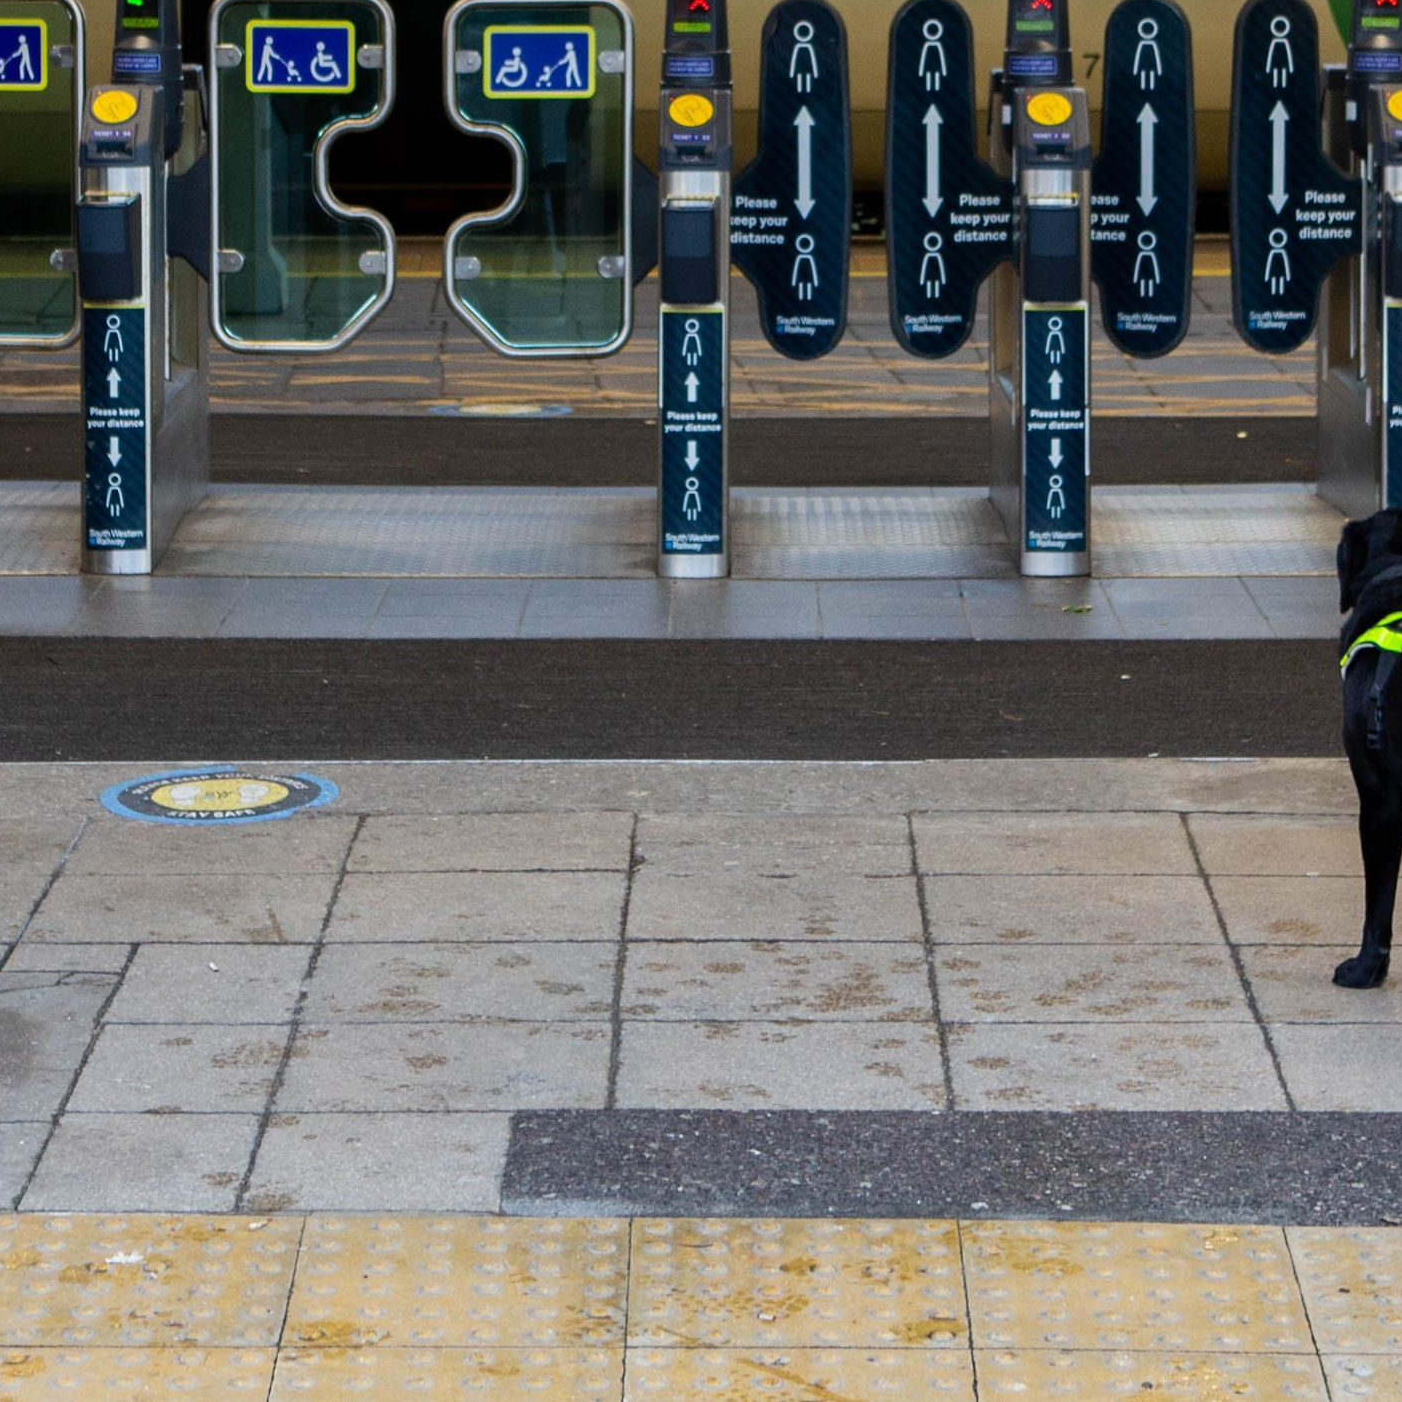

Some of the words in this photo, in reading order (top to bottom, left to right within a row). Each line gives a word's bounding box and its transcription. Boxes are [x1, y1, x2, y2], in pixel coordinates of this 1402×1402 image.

[735, 196, 778, 210] Please
[959, 194, 1001, 207] Please
[1304, 190, 1346, 204] Please
[950, 212, 980, 227] keep
[982, 213, 1011, 227] your
[1100, 213, 1130, 226] your
[1295, 208, 1326, 223] keep
[1327, 210, 1356, 224] your
[759, 216, 788, 230] your
[730, 232, 785, 245] distance
[953, 230, 1008, 243] distance
[1299, 226, 1352, 240] distance
[89, 406, 118, 417] Please
[118, 407, 141, 418] keep
[667, 410, 695, 421] Please
[696, 411, 718, 422] keep
[1030, 408, 1059, 418] Please
[1060, 409, 1081, 419] keep
[87, 419, 106, 430] your
[106, 418, 144, 428] distance
[664, 424, 684, 434] your
[685, 423, 721, 432] distance
[1027, 422, 1048, 432] your
[1048, 420, 1085, 430] distance
[213, 809, 257, 818] SAFE
